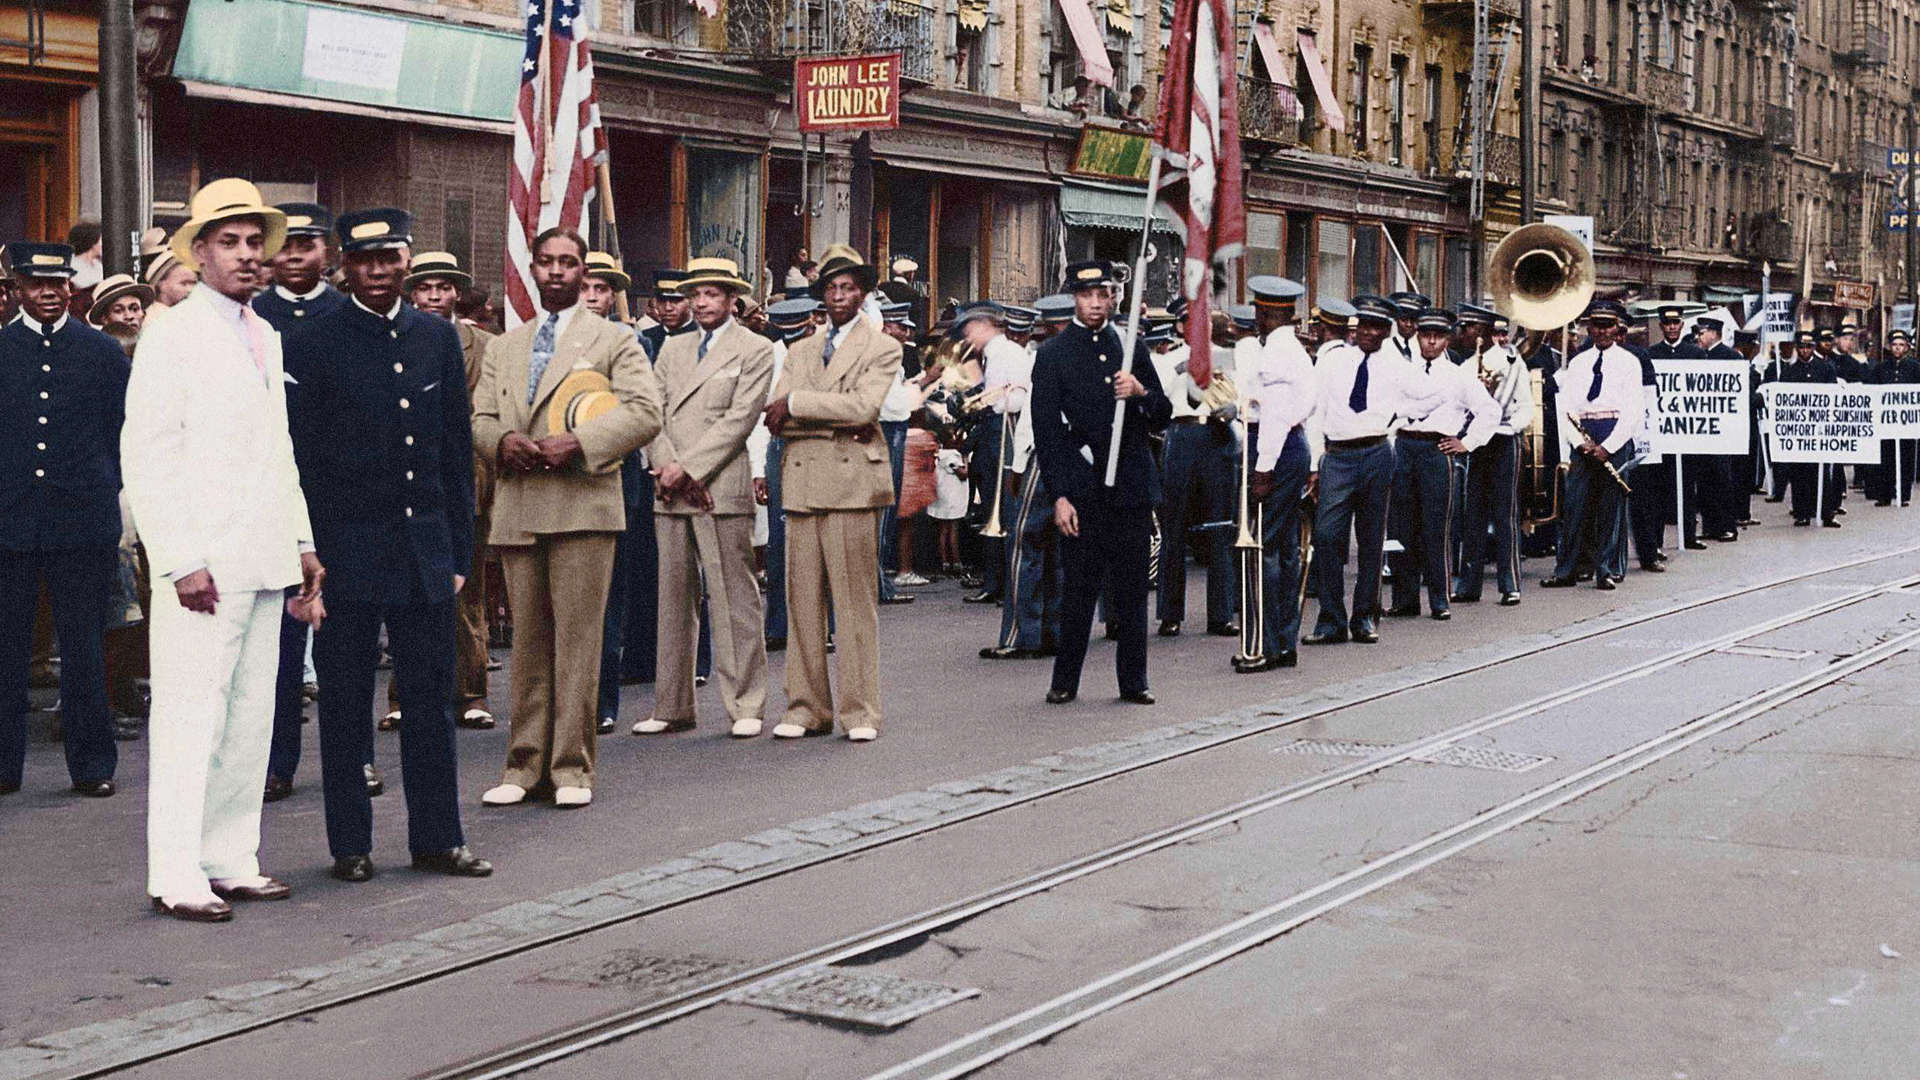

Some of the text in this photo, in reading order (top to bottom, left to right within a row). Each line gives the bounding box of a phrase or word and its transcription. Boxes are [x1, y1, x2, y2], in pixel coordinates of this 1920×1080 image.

[808, 62, 890, 86] JOHN LEE
[808, 86, 892, 124] LAUNDRY
[1685, 373, 1742, 392] WORKERS
[1668, 396, 1680, 413] &
[1683, 396, 1738, 413] WHITE
[1775, 393, 1830, 407] ORGANIZED
[1834, 395, 1871, 408] LABOR
[1775, 409, 1806, 422] BRINGS
[1809, 409, 1830, 422] MORE
[1833, 410, 1873, 423] SUNSHINE
[1900, 409, 1920, 425] QUI
[1775, 424, 1816, 437] COMFORT
[1824, 425, 1874, 437] HAPPINESS
[1779, 438, 1857, 451] TO THE HOME
